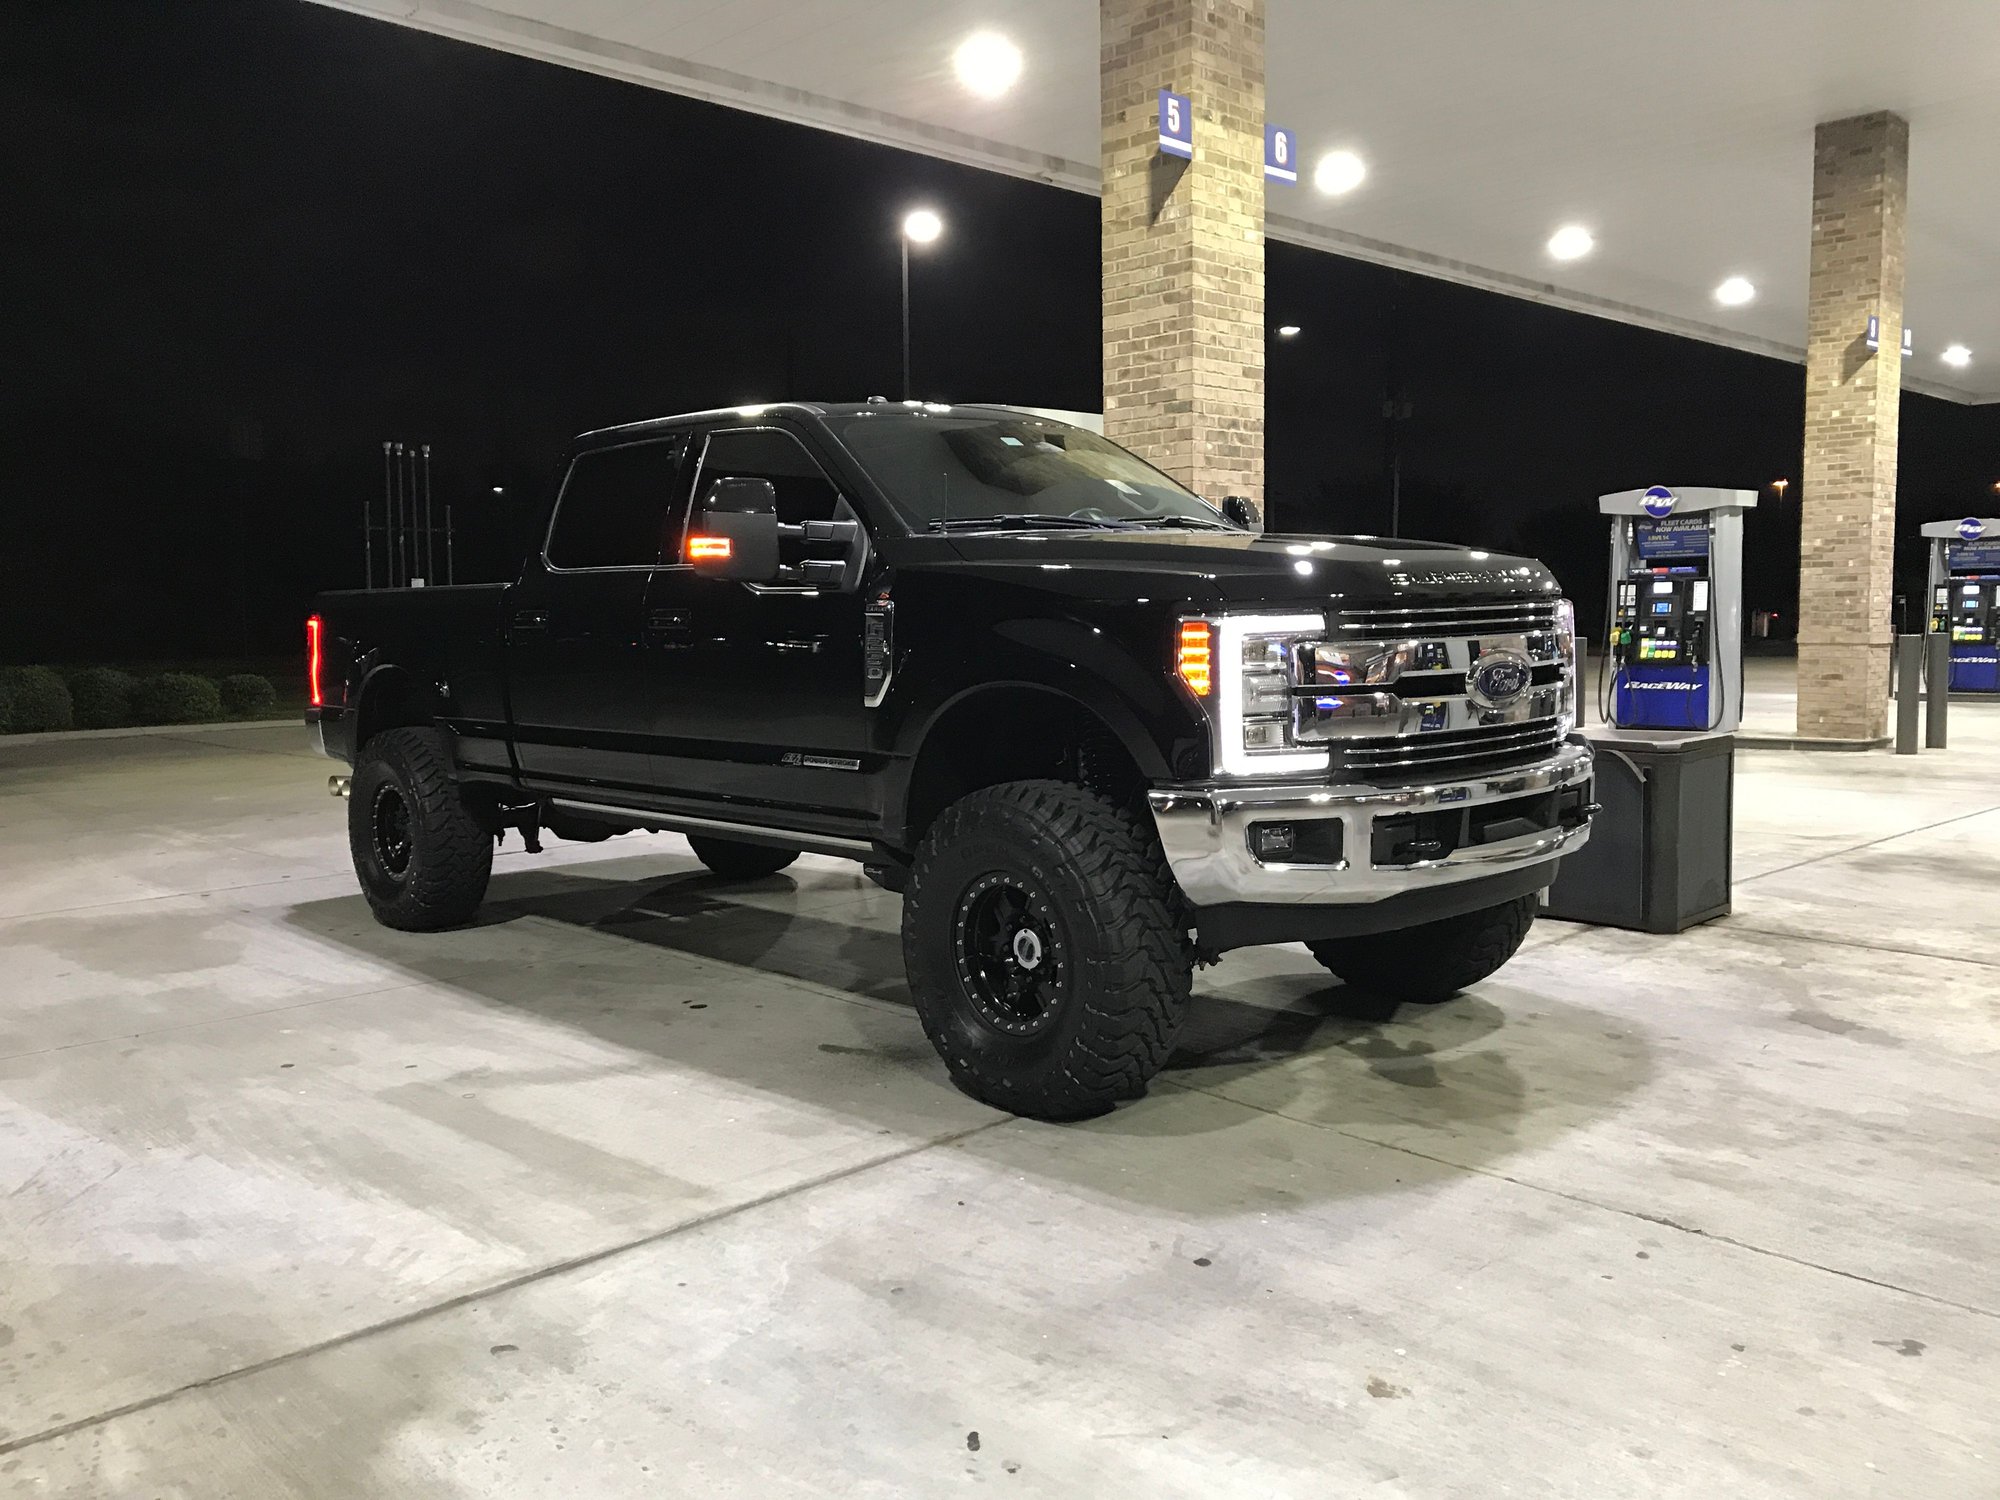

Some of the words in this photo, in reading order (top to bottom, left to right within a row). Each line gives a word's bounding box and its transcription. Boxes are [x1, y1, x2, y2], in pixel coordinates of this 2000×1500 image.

[1167, 97, 1180, 132] 5
[1275, 131, 1288, 164] 6
[1490, 668, 1519, 691] Ford
